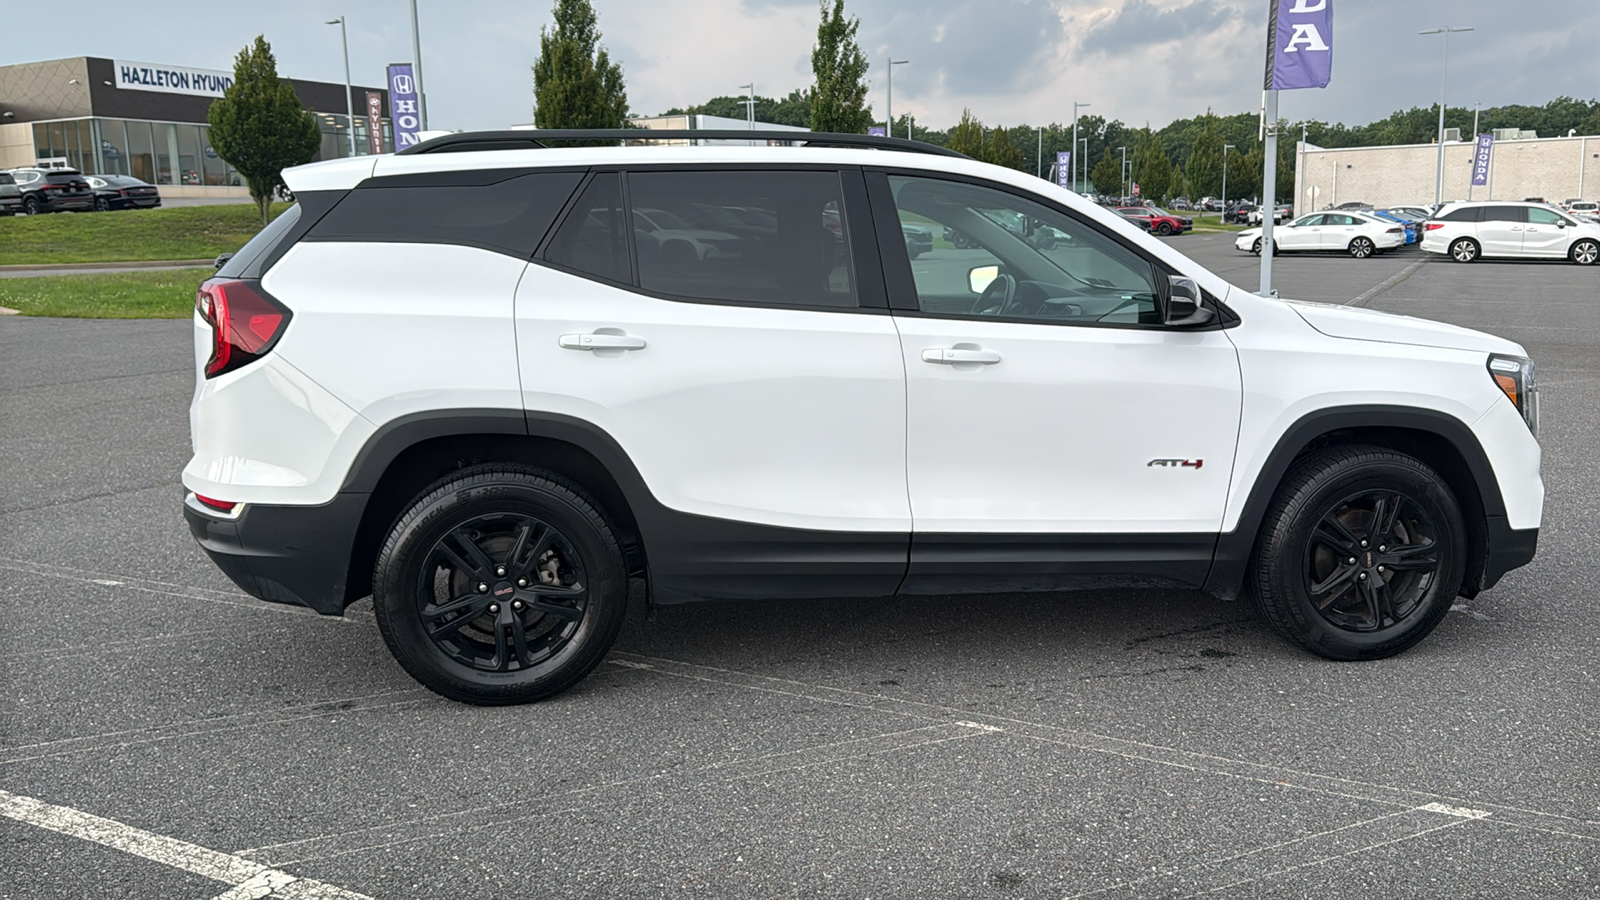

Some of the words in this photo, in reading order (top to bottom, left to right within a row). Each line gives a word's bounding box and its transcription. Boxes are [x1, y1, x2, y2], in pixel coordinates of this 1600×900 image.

[121, 65, 189, 89] HAZLETON
[1475, 147, 1489, 180] HONDA
[1147, 459, 1203, 470] AT4
[494, 587, 513, 596] GMC
